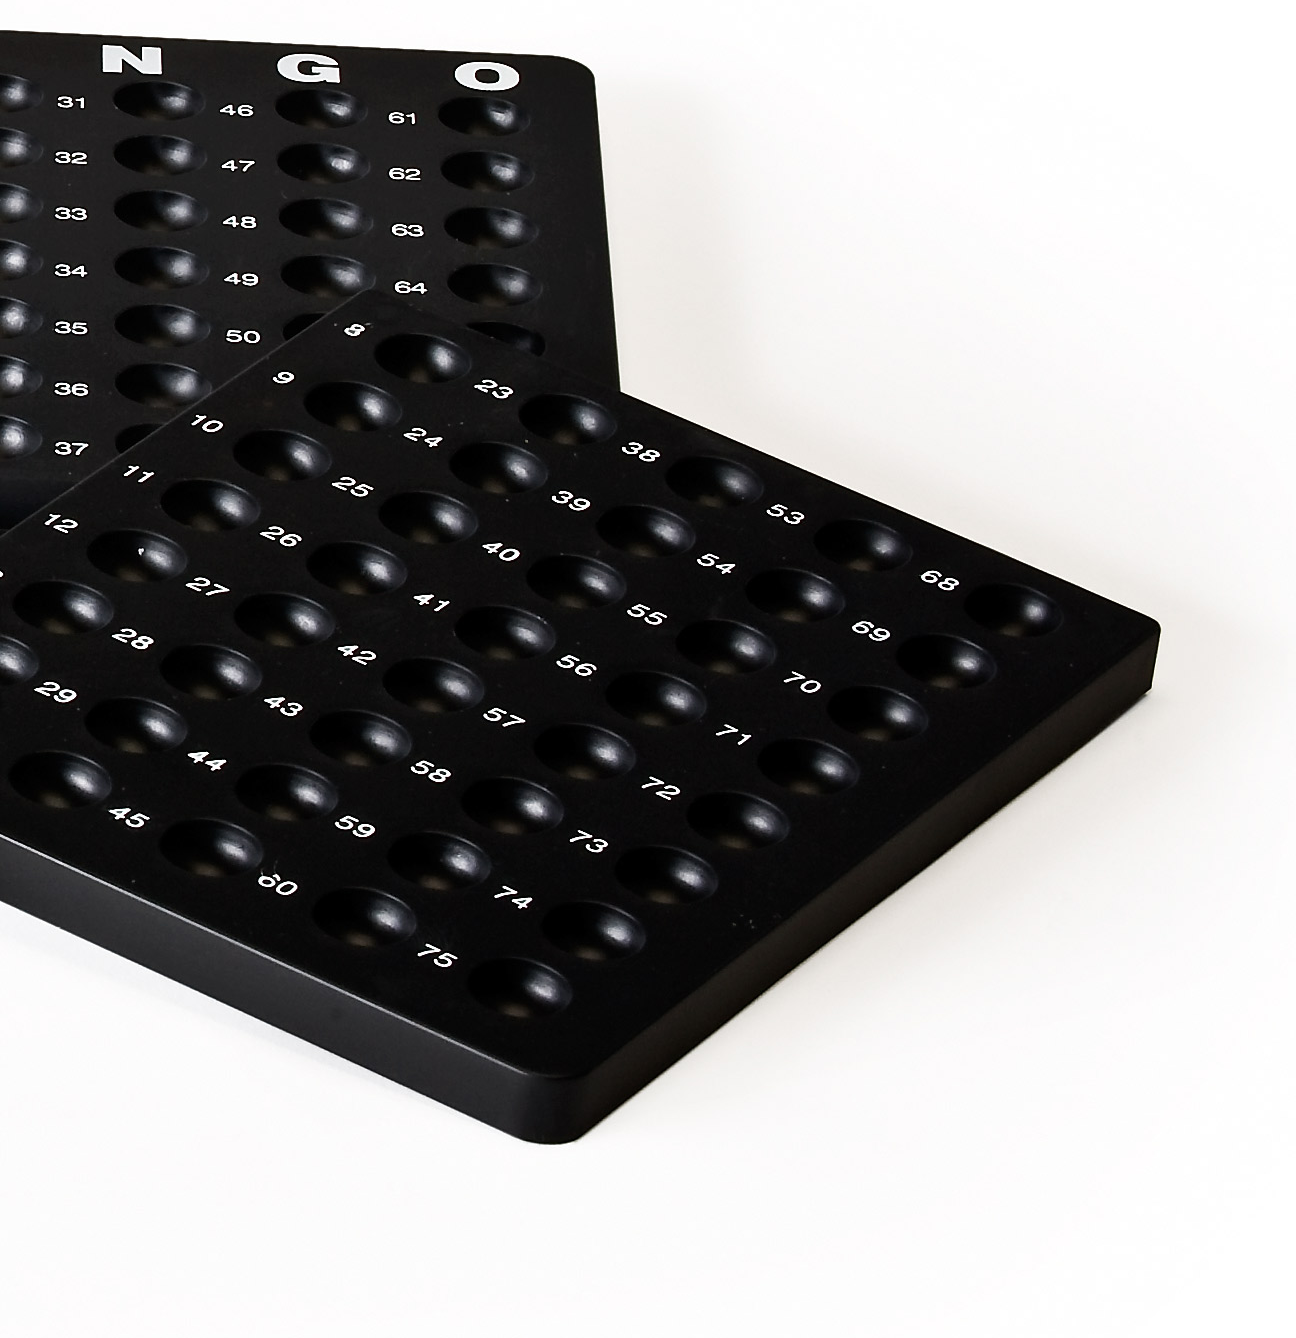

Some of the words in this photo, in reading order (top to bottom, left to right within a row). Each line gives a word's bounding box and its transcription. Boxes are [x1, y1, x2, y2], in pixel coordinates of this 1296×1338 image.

[57, 95, 85, 109] 31
[219, 104, 254, 117] 46
[388, 111, 416, 125] 61
[102, 44, 163, 75] N
[276, 53, 341, 84] G
[454, 61, 520, 91] O
[54, 151, 88, 165] 32
[221, 159, 256, 172] 47
[388, 167, 421, 181] 62
[54, 206, 88, 221] 33
[222, 215, 257, 229] 48
[391, 223, 425, 238] 63
[54, 263, 88, 278] 34
[223, 272, 259, 287] 49
[394, 280, 428, 295] 64
[54, 320, 88, 335] 35
[225, 329, 261, 344] 50
[54, 382, 89, 397] 36
[54, 441, 89, 456] 37
[343, 323, 366, 337] 8
[473, 379, 514, 399] 23
[621, 441, 661, 462] 38
[766, 503, 805, 525] 53
[920, 570, 960, 591] 68
[191, 414, 224, 433] 10
[331, 476, 374, 498] 25
[482, 542, 521, 562] 40
[626, 603, 668, 626] 55
[783, 670, 822, 694] 70
[272, 371, 295, 384] 9
[403, 427, 443, 448] 24
[551, 490, 591, 512] 39
[696, 553, 736, 575] 54
[851, 620, 891, 642] 69
[44, 513, 79, 534] 12
[185, 576, 230, 596] 27
[337, 645, 377, 666] 42
[482, 707, 526, 728] 57
[641, 776, 681, 801] 72
[123, 465, 155, 483] 11
[259, 525, 303, 547] 26
[413, 593, 450, 612] 41
[555, 654, 597, 677] 56
[715, 724, 752, 746] 71
[111, 628, 155, 650] 28
[263, 696, 304, 717] 43
[410, 760, 452, 783] 58
[569, 829, 609, 853] 73
[33, 681, 78, 703] 29
[187, 751, 227, 772] 44
[334, 815, 376, 838] 59
[493, 885, 533, 910] 74
[108, 807, 151, 828] 45
[257, 873, 298, 896] 60
[417, 943, 458, 968] 75
